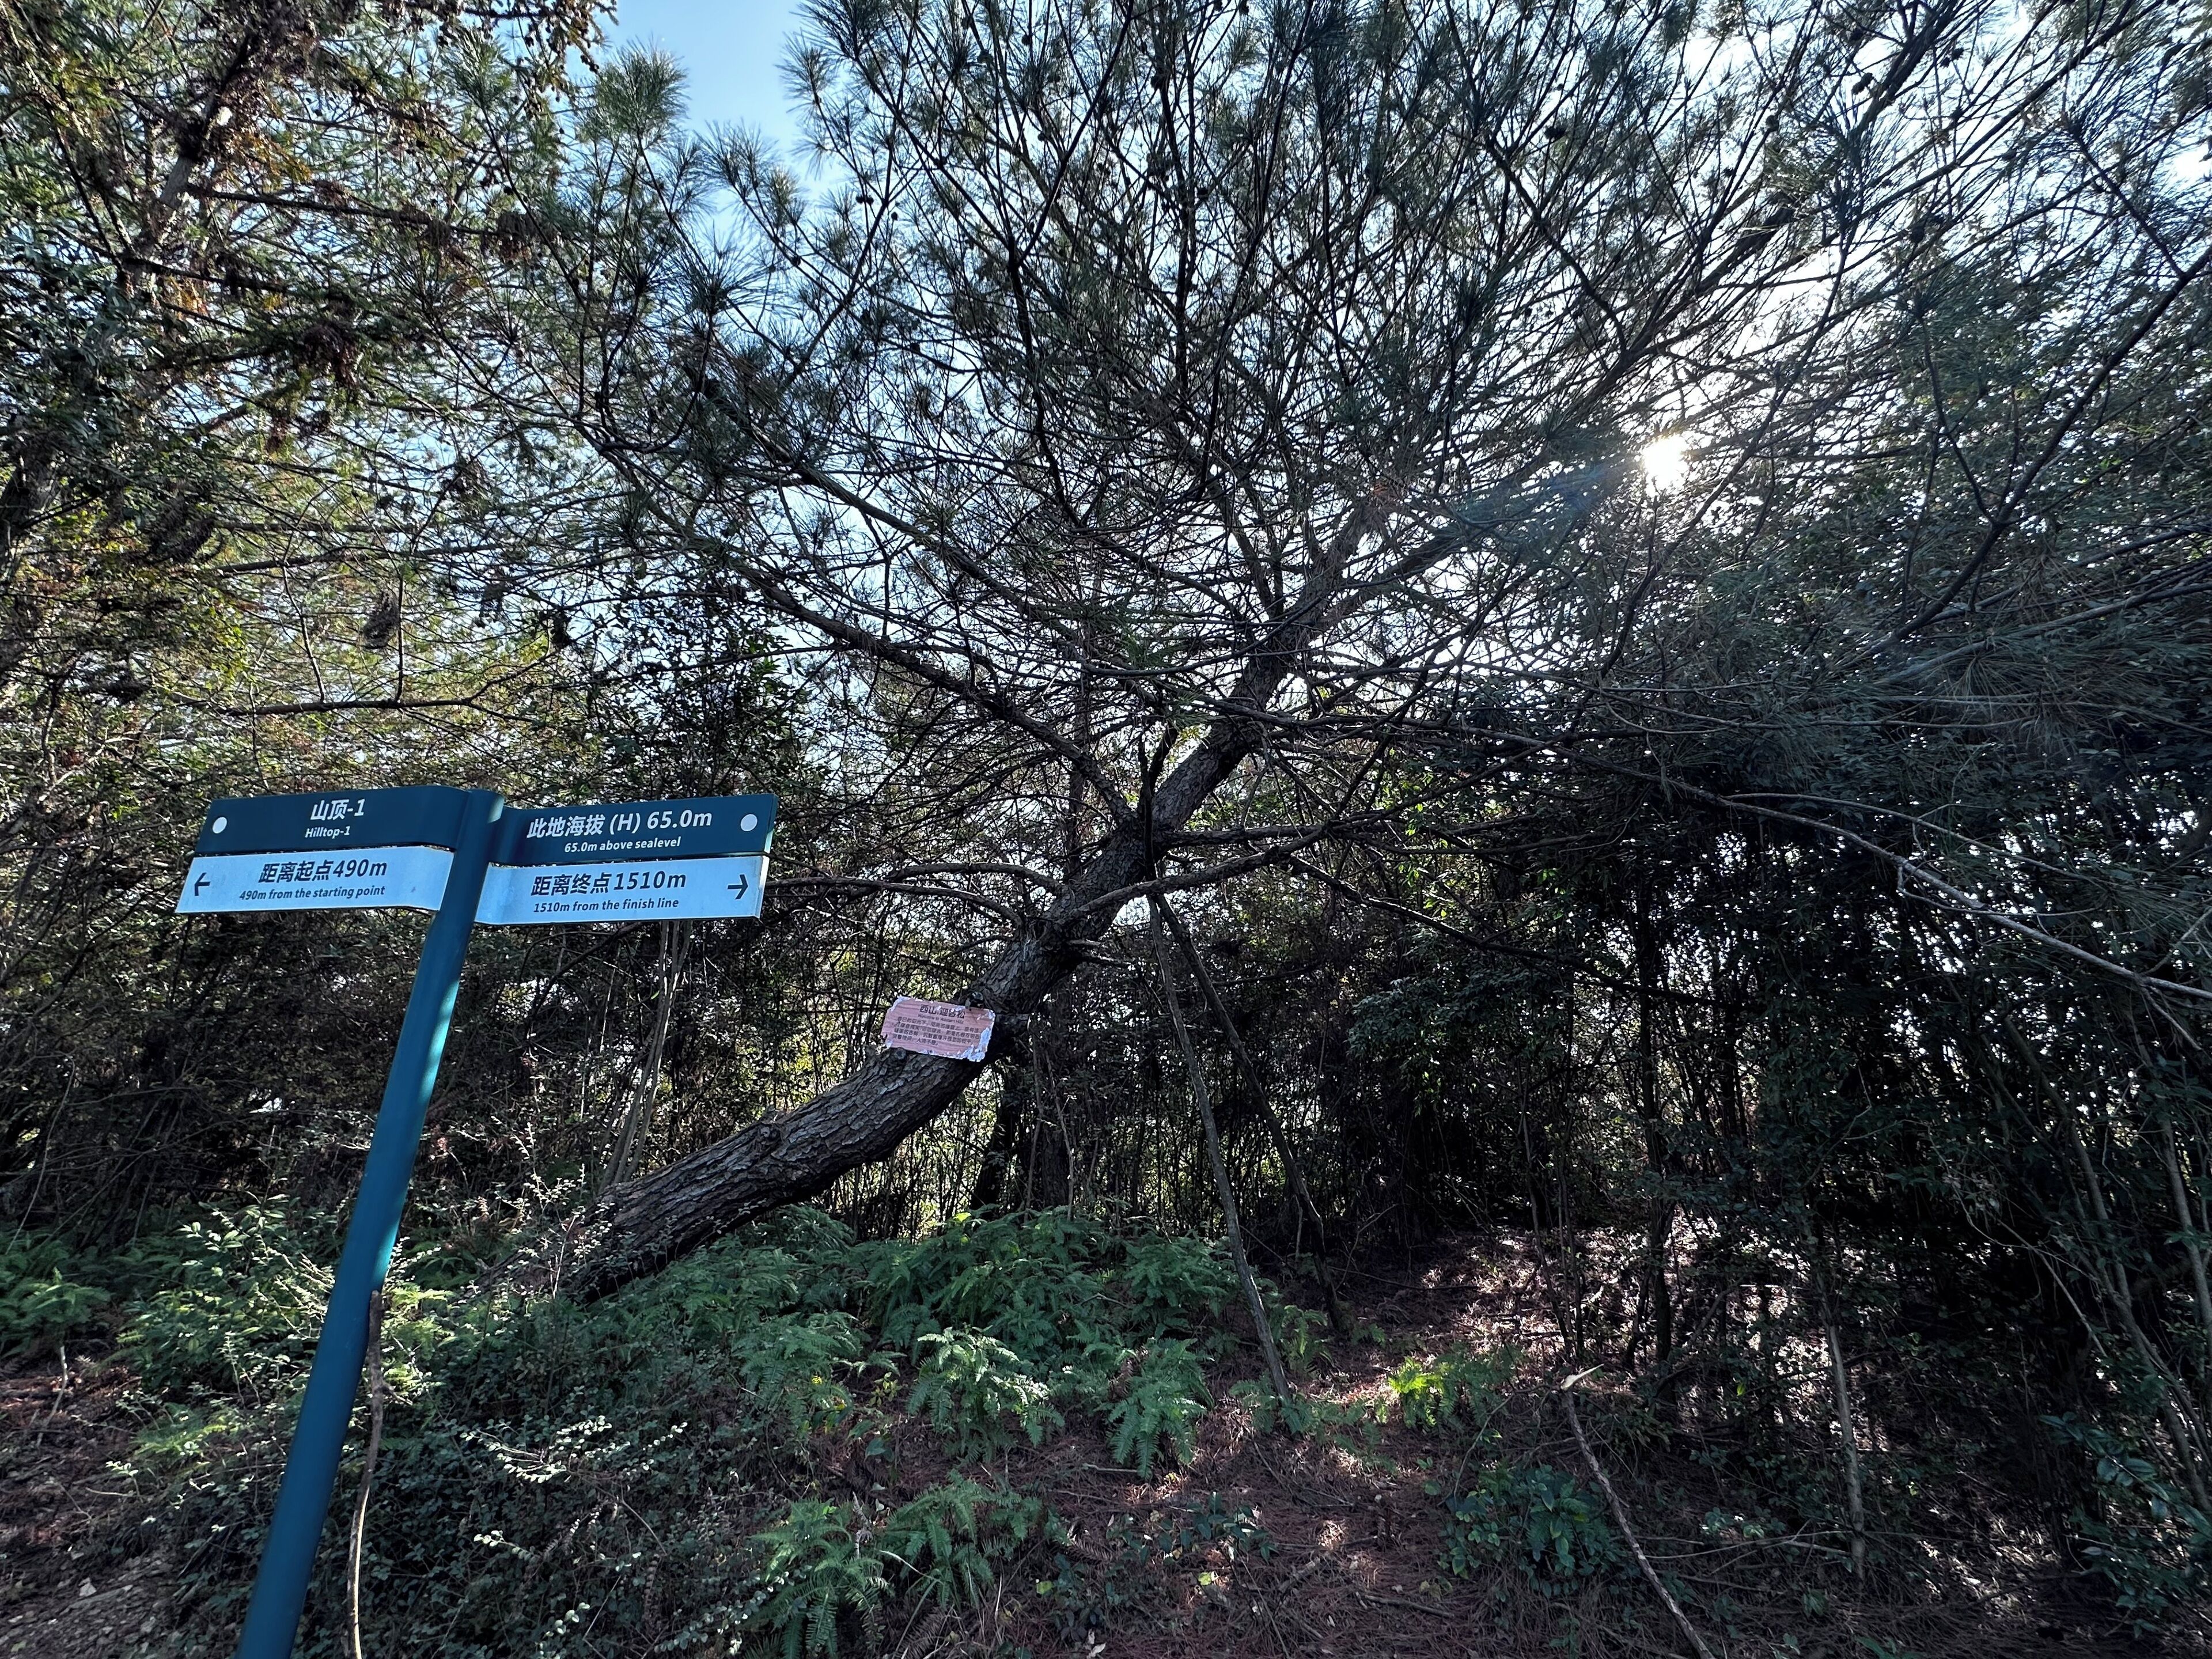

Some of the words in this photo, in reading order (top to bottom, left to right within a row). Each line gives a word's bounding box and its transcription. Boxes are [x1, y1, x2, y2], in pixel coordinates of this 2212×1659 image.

[310, 798, 366, 821] 山顶-1
[305, 825, 350, 839] Hilltop-1
[527, 815, 605, 838] 此地海拔
[609, 813, 641, 835] (H)
[647, 809, 712, 829] 65.0m
[564, 842, 598, 853] 65.0m
[599, 840, 633, 851] above
[634, 836, 681, 849] sealevel
[258, 859, 387, 882] 距离起点490m
[239, 891, 266, 900] 490m
[268, 889, 292, 899] from
[294, 888, 310, 898] the
[312, 886, 354, 899] starting
[355, 885, 385, 898] point
[531, 871, 686, 896] 距离终点1510m
[533, 902, 570, 912] 1510m
[573, 901, 599, 911] from
[602, 900, 620, 910] the
[622, 898, 654, 909] finish
[657, 897, 679, 908] line
